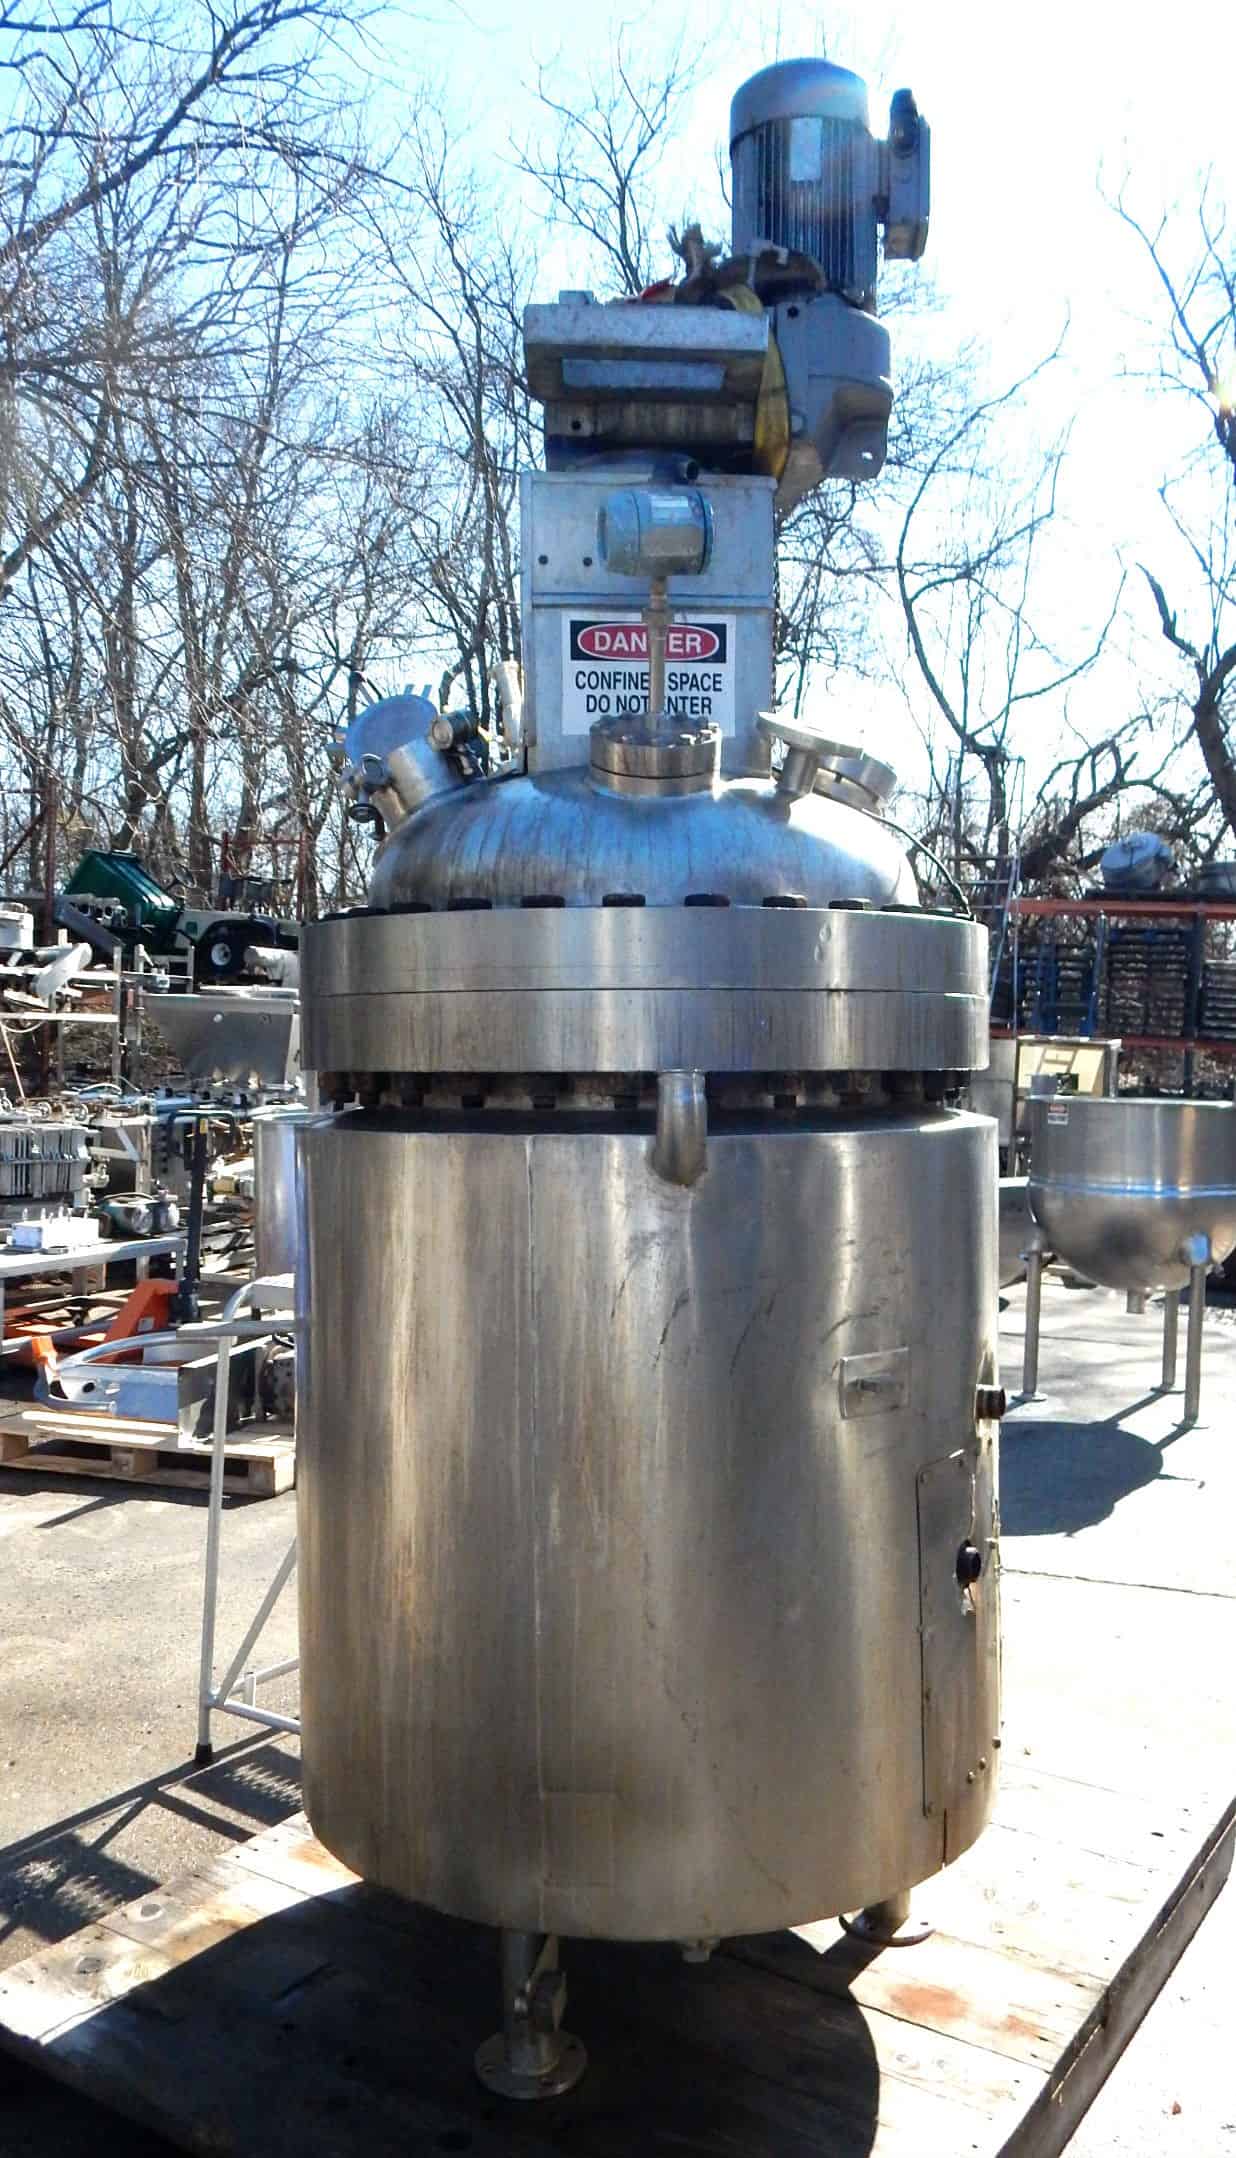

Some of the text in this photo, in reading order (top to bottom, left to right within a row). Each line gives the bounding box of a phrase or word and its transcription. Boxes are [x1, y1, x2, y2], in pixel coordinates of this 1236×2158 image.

[594, 631, 702, 653] DANER
[575, 670, 723, 692] CONFINE SPACE
[586, 694, 712, 715] DO NOT NTER
